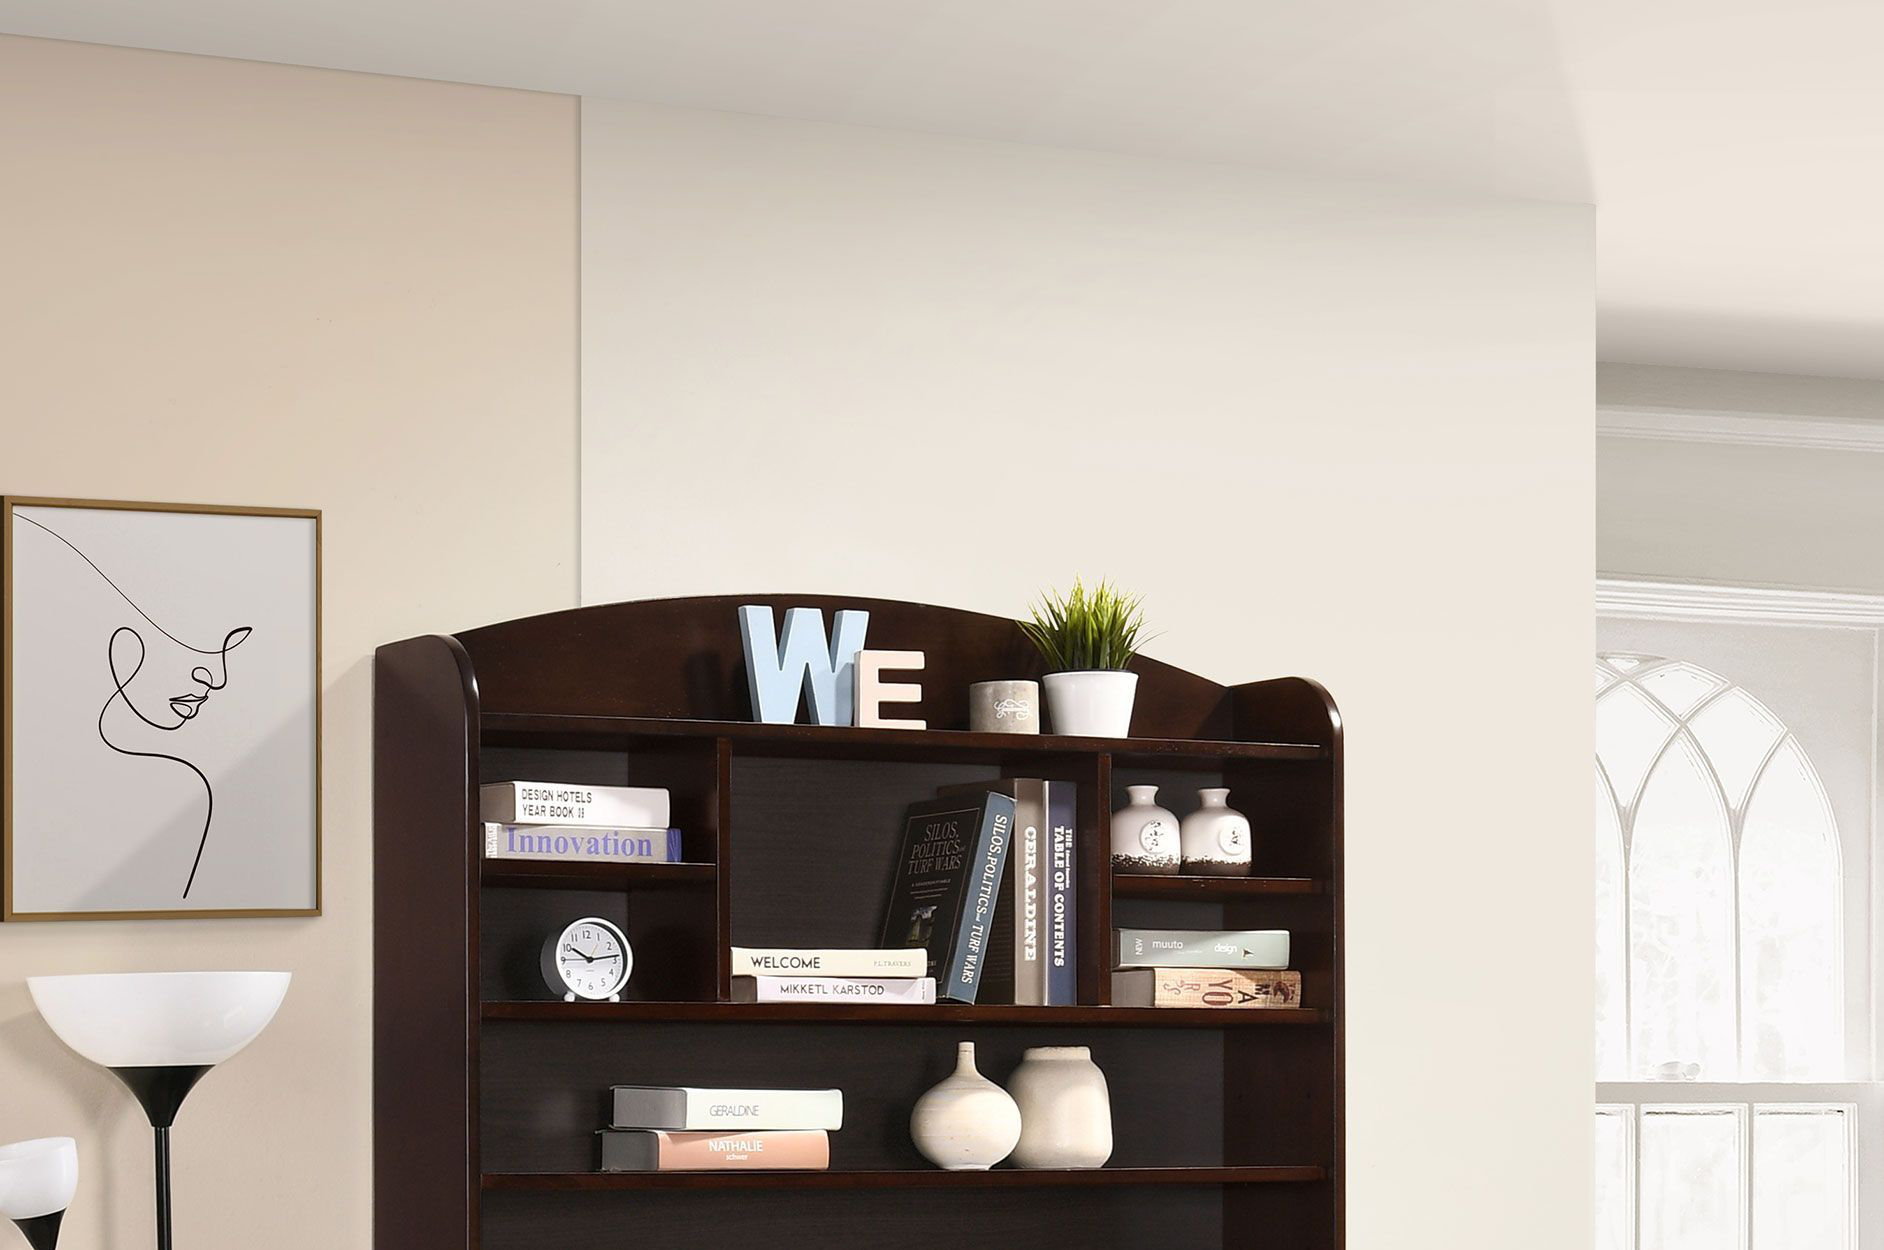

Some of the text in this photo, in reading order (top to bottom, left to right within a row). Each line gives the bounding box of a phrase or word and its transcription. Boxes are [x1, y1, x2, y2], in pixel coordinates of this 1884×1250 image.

[522, 788, 592, 803] DESIGN HOTELS
[522, 804, 546, 817] YEAR
[549, 805, 574, 818] BOOK
[506, 826, 652, 857] Innovation
[1065, 828, 1073, 848] THE
[911, 840, 961, 859] POLITICS
[908, 855, 962, 875] TURF WARS
[1054, 826, 1065, 967] TABLE OF CONTENTS
[571, 933, 578, 942] 11
[582, 930, 591, 939] 12
[968, 925, 984, 955] TURF
[563, 943, 572, 952] 10
[606, 941, 612, 950] 2
[1135, 938, 1144, 955] NEW
[1152, 940, 1184, 950] muuto
[1214, 944, 1237, 955] design
[750, 956, 821, 969] WELCOME
[565, 969, 571, 978] 8
[609, 968, 614, 976] 4
[961, 954, 977, 984] WARS
[576, 978, 582, 987] 7
[587, 982, 594, 990] 6
[600, 978, 606, 987] 5
[780, 984, 885, 996] MIKKETL KARSTOD
[709, 1104, 760, 1117] GERALDINE
[708, 1140, 763, 1152] NATHALIE
